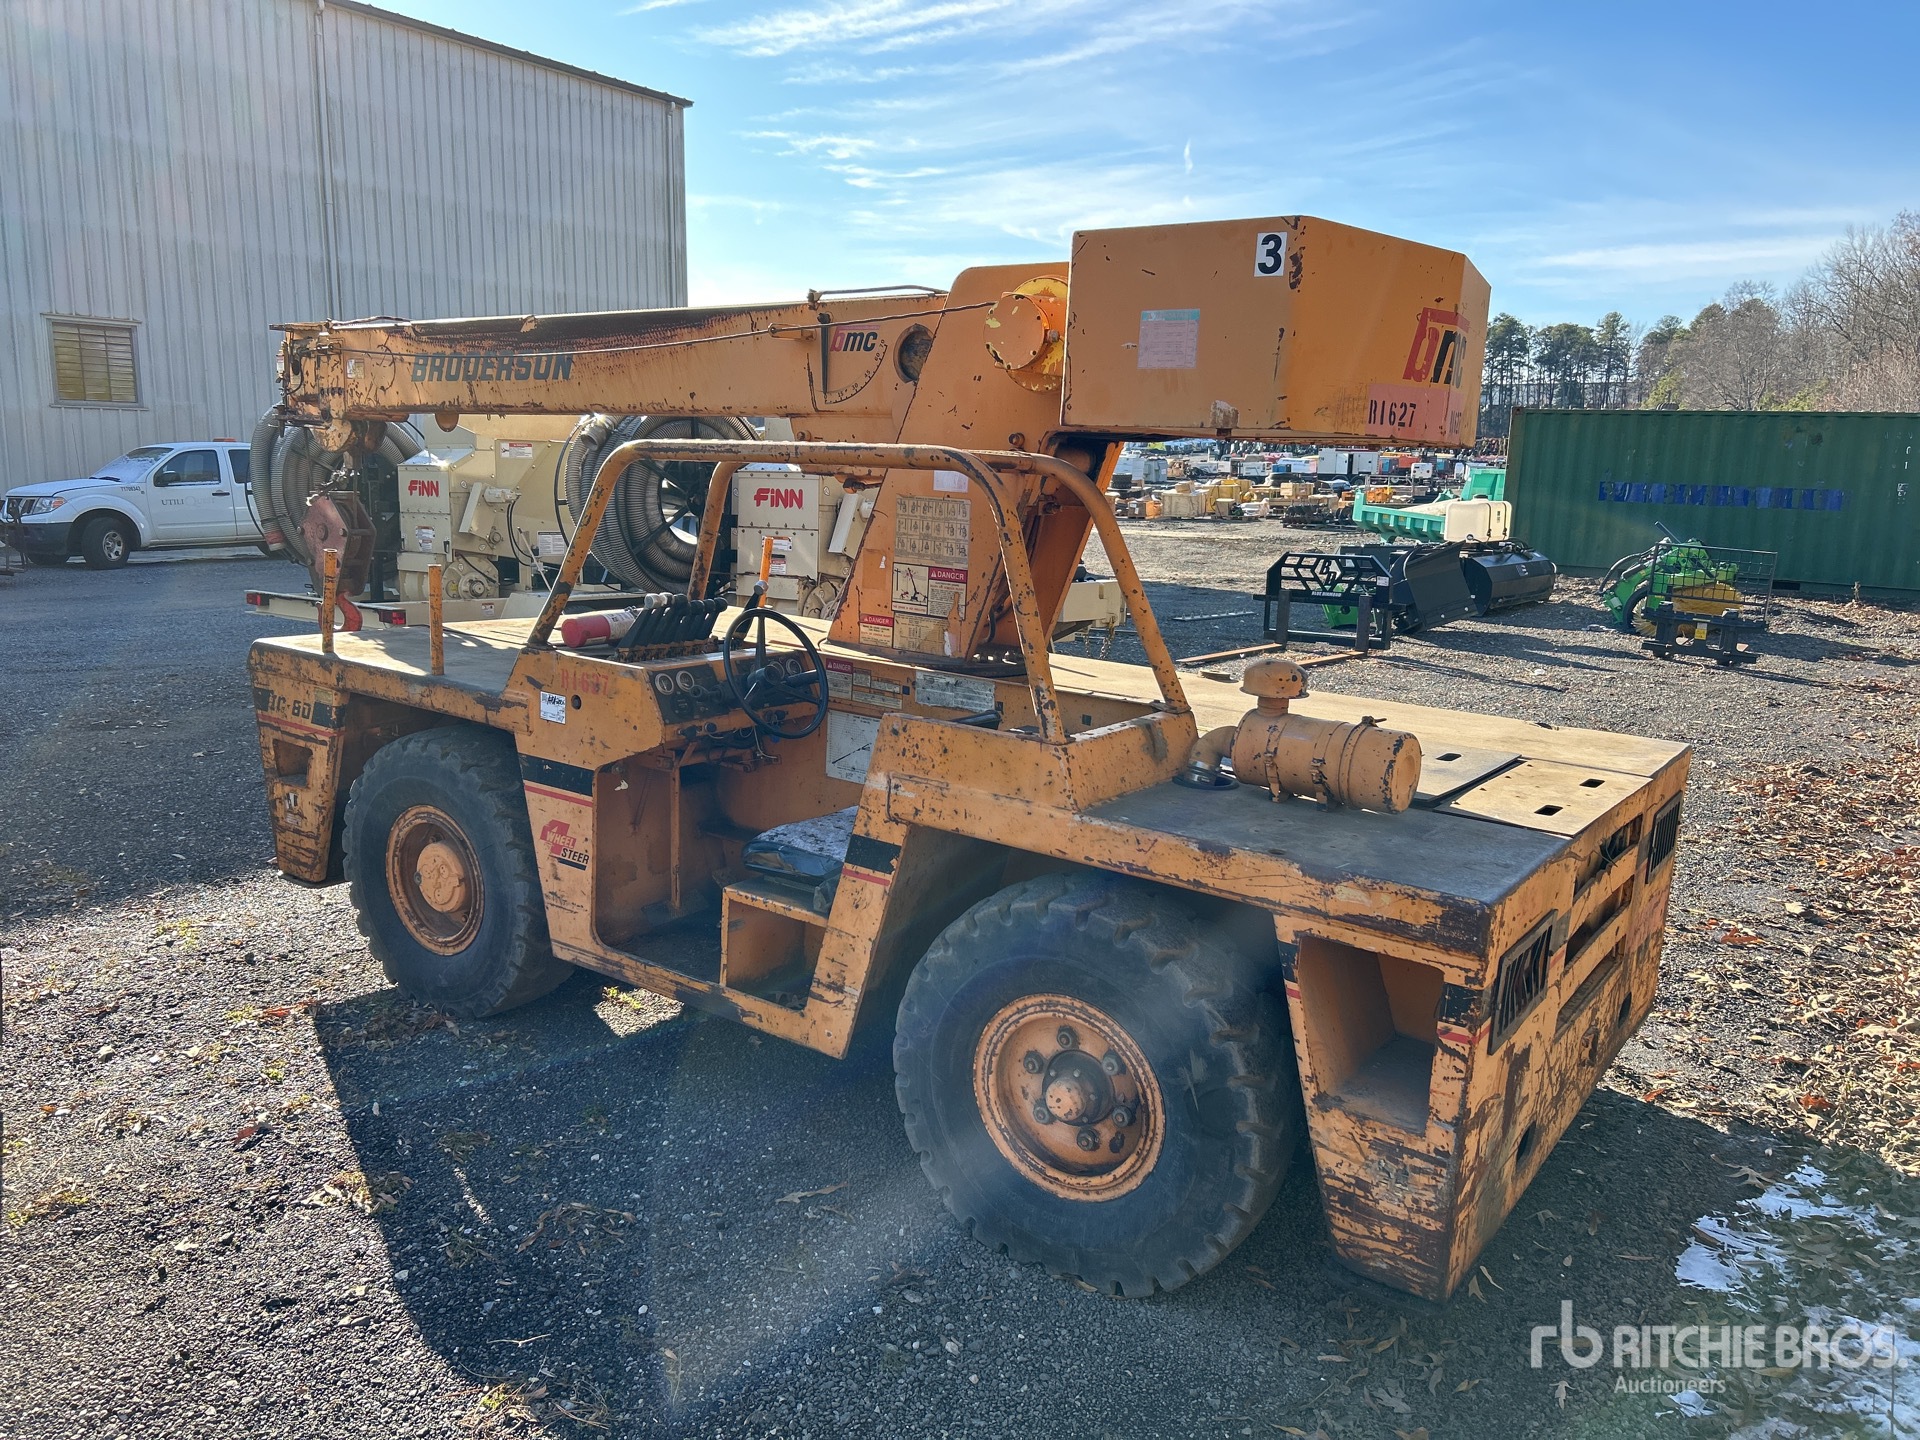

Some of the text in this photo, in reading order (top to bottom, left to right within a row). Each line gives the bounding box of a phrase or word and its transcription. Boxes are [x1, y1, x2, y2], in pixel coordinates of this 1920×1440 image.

[1257, 233, 1282, 274] 3
[830, 325, 880, 352] bmc
[411, 349, 574, 382] BRODERSON
[1368, 399, 1417, 428] R1627
[937, 570, 964, 581] DANGER
[868, 616, 889, 625] DANGER
[832, 662, 851, 671] DANGER
[546, 831, 575, 849] WHEEL
[561, 847, 590, 865] STEER
